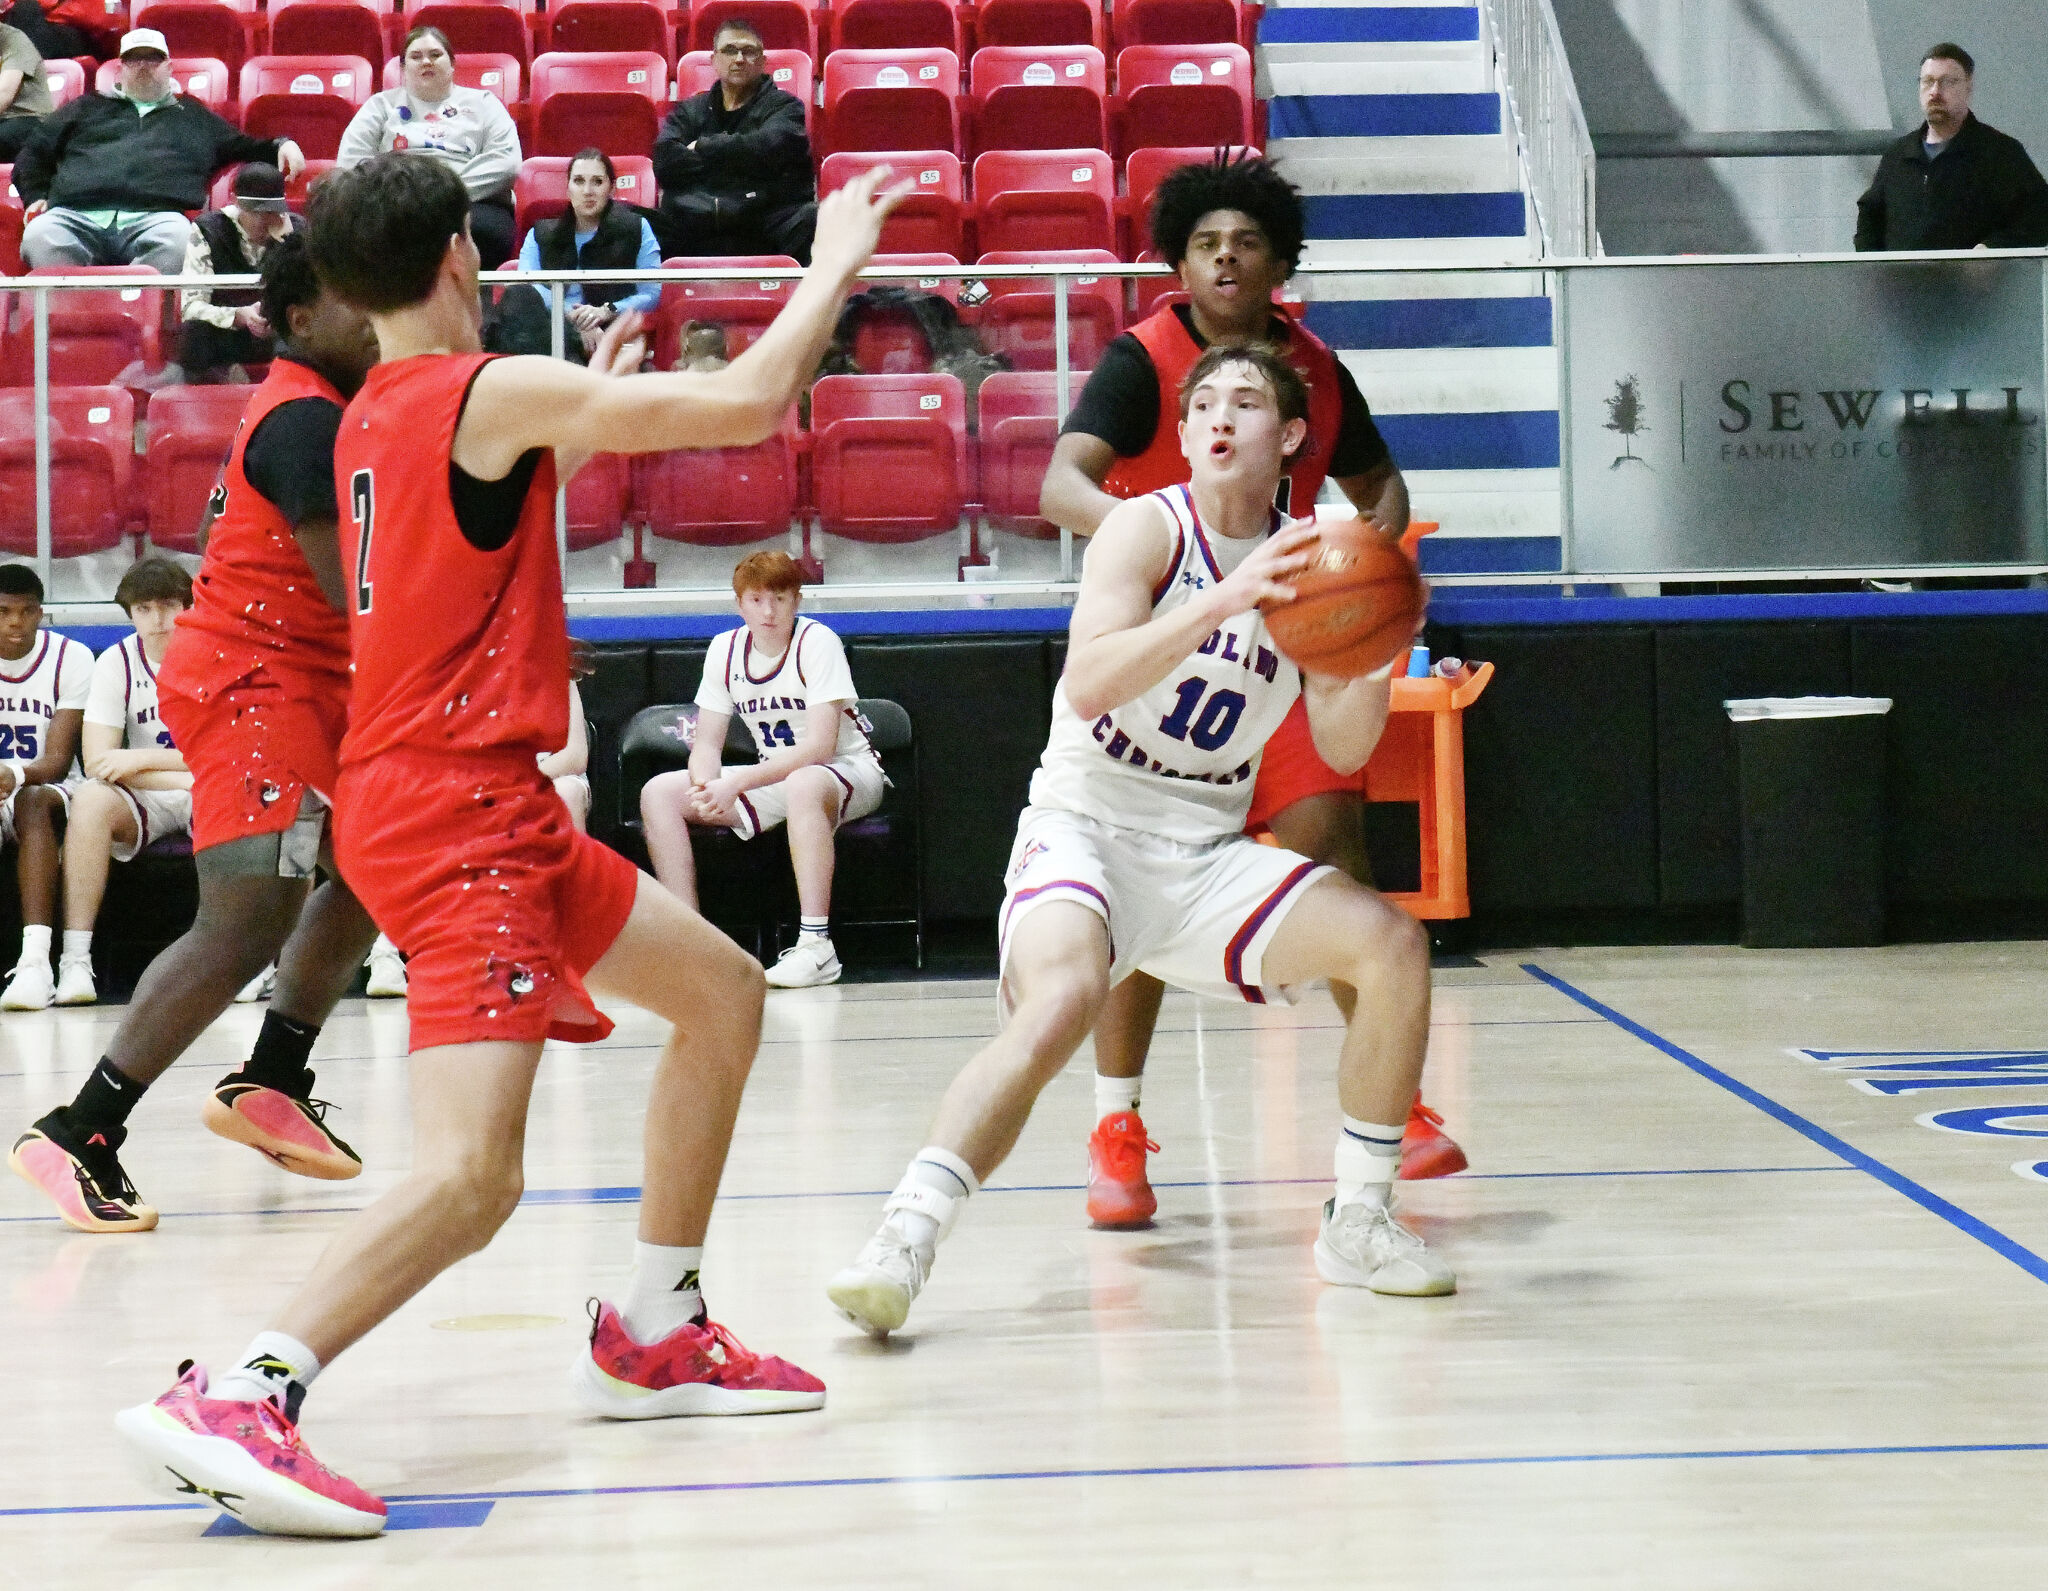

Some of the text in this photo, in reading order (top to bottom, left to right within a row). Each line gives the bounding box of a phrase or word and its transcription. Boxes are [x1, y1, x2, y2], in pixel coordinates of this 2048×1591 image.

[776, 70, 789, 80] 33
[922, 67, 936, 78] 35
[1068, 65, 1082, 76] 37
[631, 71, 645, 82] 31
[922, 171, 937, 182] 35
[1074, 169, 1089, 180] 37
[618, 175, 631, 187] 31
[923, 396, 938, 407] 35
[1720, 442, 1818, 461] FAMILY
[1830, 440, 1868, 459] OF
[351, 468, 375, 615] 2
[1158, 675, 1247, 752] 10
[758, 719, 796, 748] 14
[0, 723, 38, 761] 25
